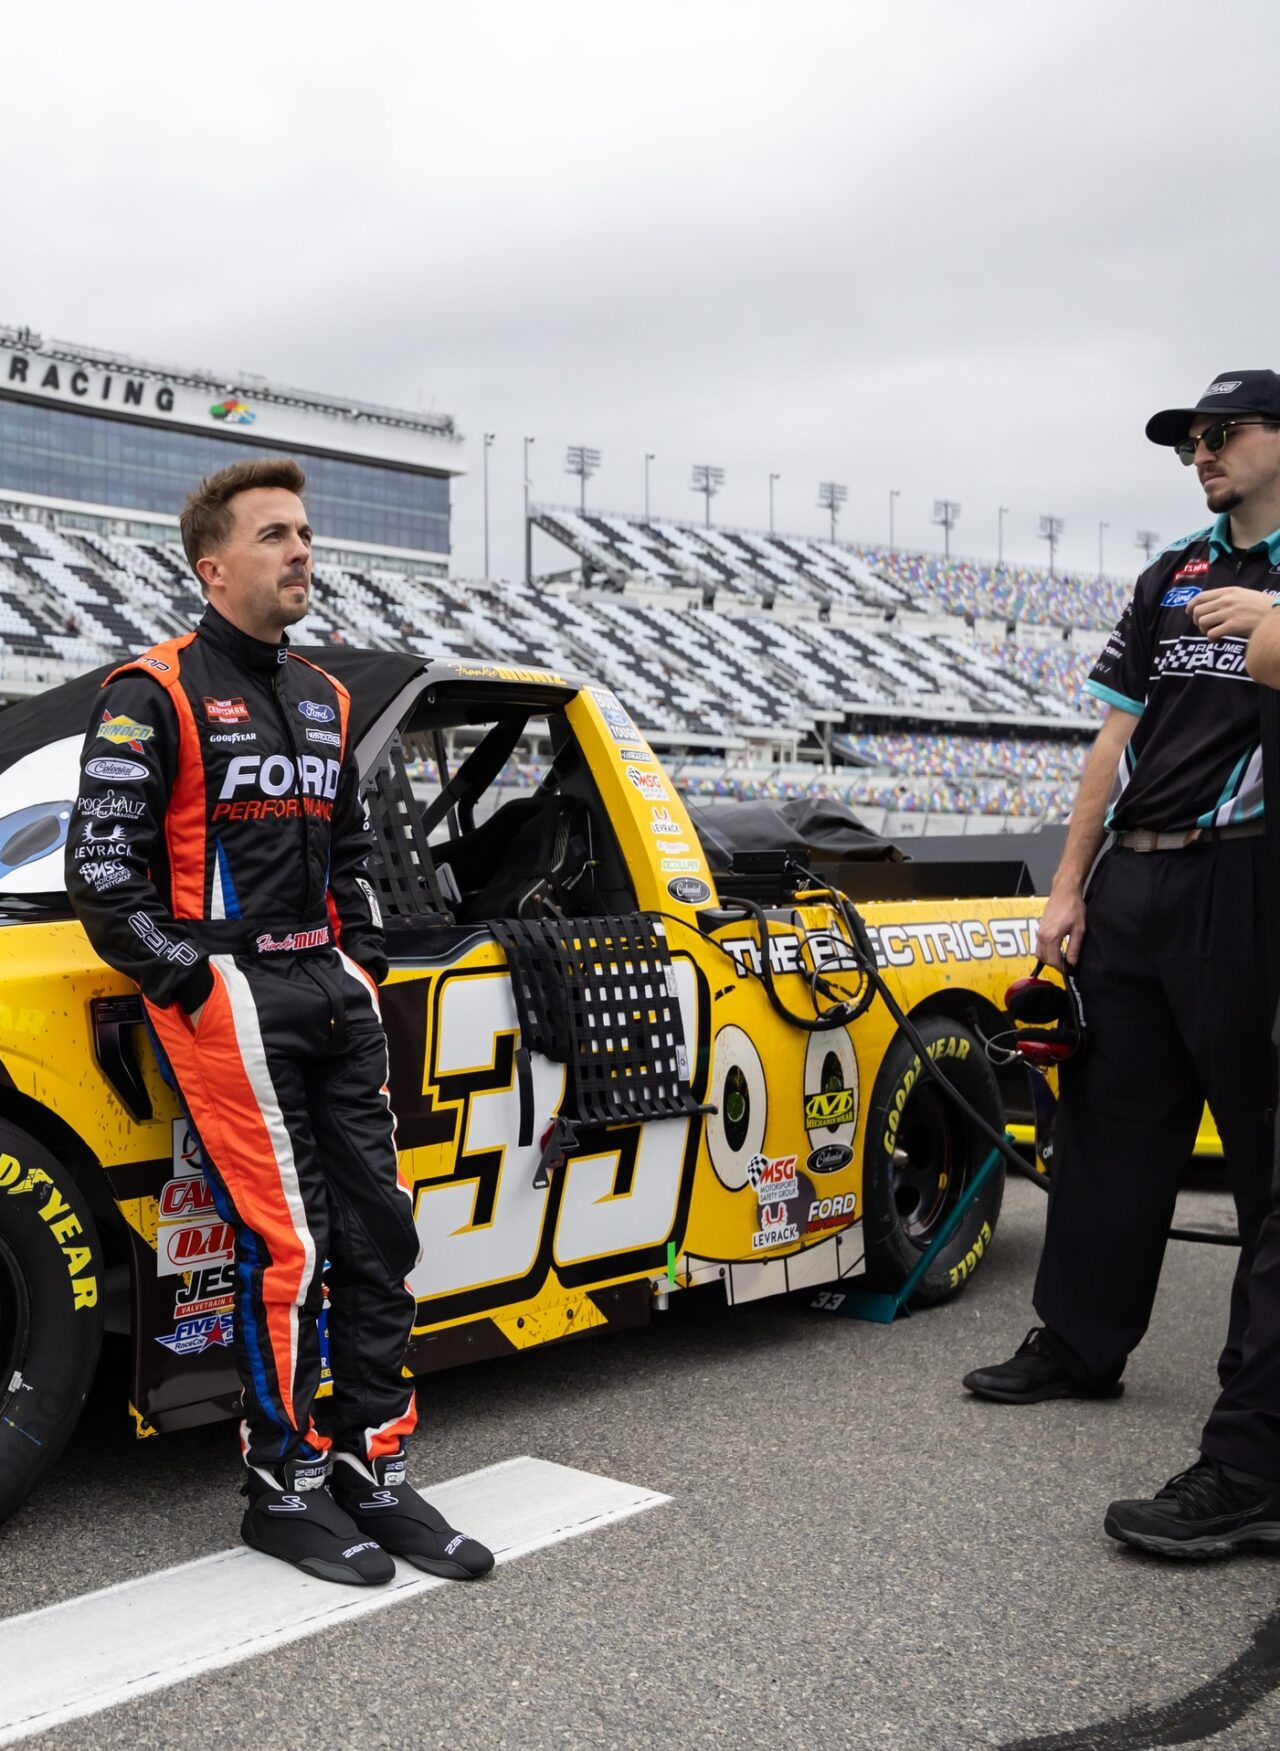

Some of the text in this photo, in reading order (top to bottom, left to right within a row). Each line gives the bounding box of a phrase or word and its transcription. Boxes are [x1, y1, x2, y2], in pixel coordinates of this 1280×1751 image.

[9, 356, 175, 413] RACING
[448, 662, 567, 685] Frankie MUNIZ
[305, 702, 328, 720] Ford
[98, 724, 152, 740] SUNOCO
[209, 732, 257, 744] GOODYEAR
[94, 761, 135, 776] Colonial
[218, 754, 341, 800] FORD
[651, 823, 680, 834] LEVRACK
[74, 843, 133, 859] LEVRACK
[722, 935, 800, 977] THE
[805, 920, 986, 974] ELECTRIC
[883, 1036, 971, 1155] GOODYEAR
[413, 956, 699, 1301] 33
[760, 1158, 797, 1185] MSG
[760, 1179, 797, 1194] MOTORSPORTS
[760, 1191, 777, 1203] SAFETY
[807, 1193, 856, 1222] FORD
[753, 1228, 797, 1248] LEVRACK
[949, 1220, 992, 1288] EAGLE
[180, 1298, 226, 1314] VALVETRAIN
[811, 1292, 847, 1310] 33
[175, 1315, 217, 1340] FIVE
[175, 1337, 206, 1350] RaceCar
